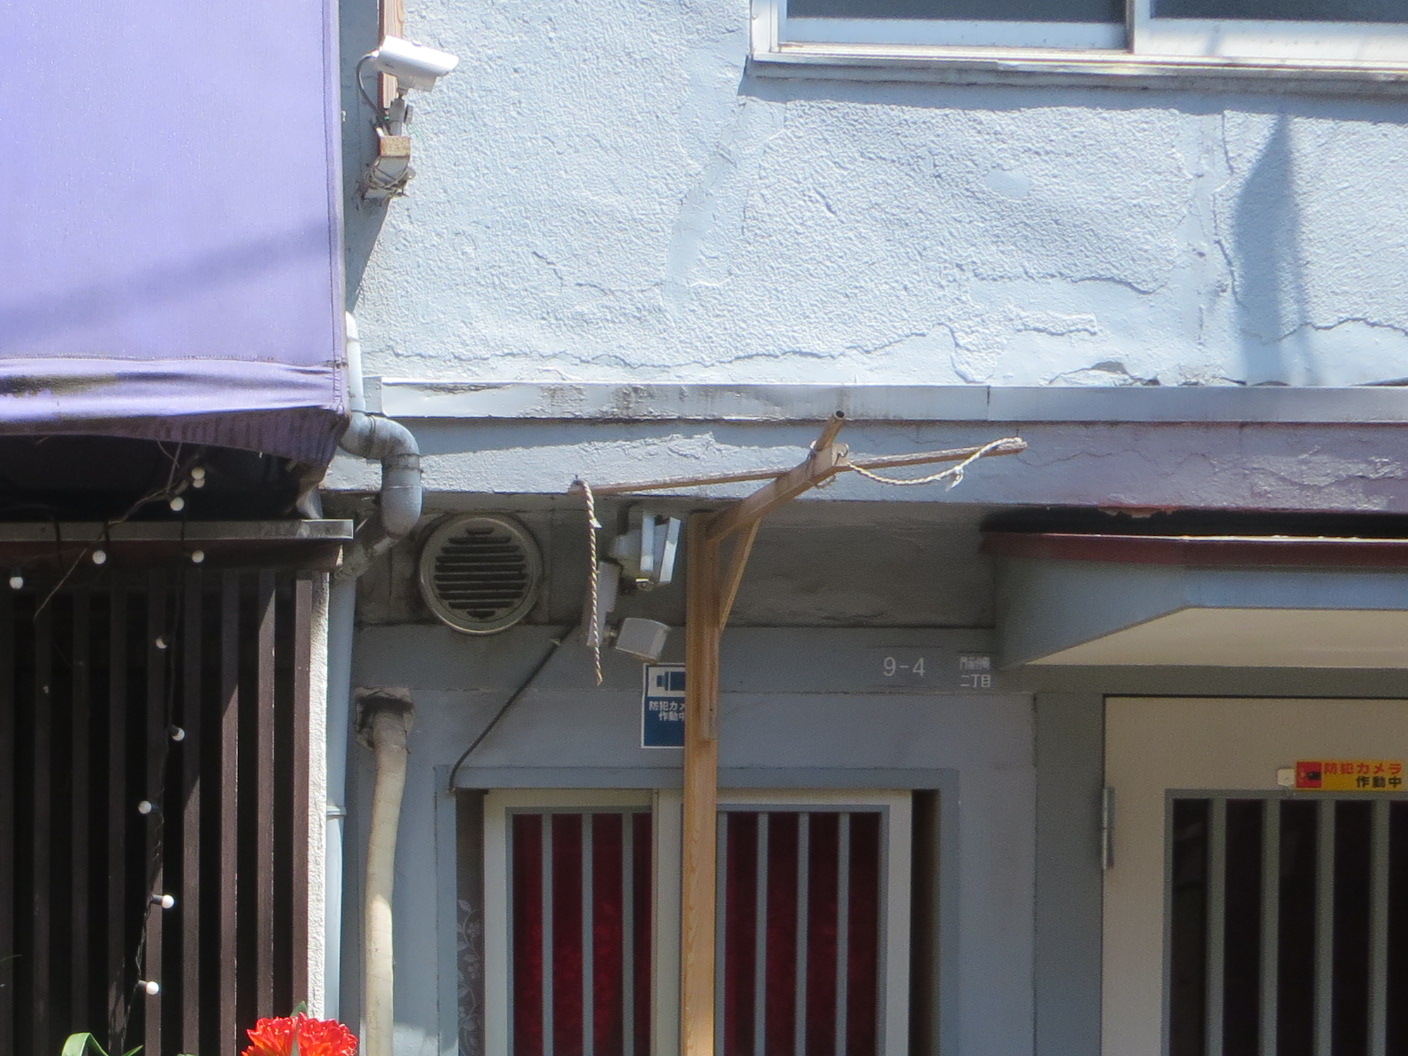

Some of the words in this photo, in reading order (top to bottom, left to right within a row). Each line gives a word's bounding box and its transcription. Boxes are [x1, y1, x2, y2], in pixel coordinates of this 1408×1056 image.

[883, 656, 927, 677] 9-4
[959, 673, 991, 688] 二丁目
[1323, 763, 1403, 775] 防犯カメラ
[1356, 776, 1403, 788] 作動中
